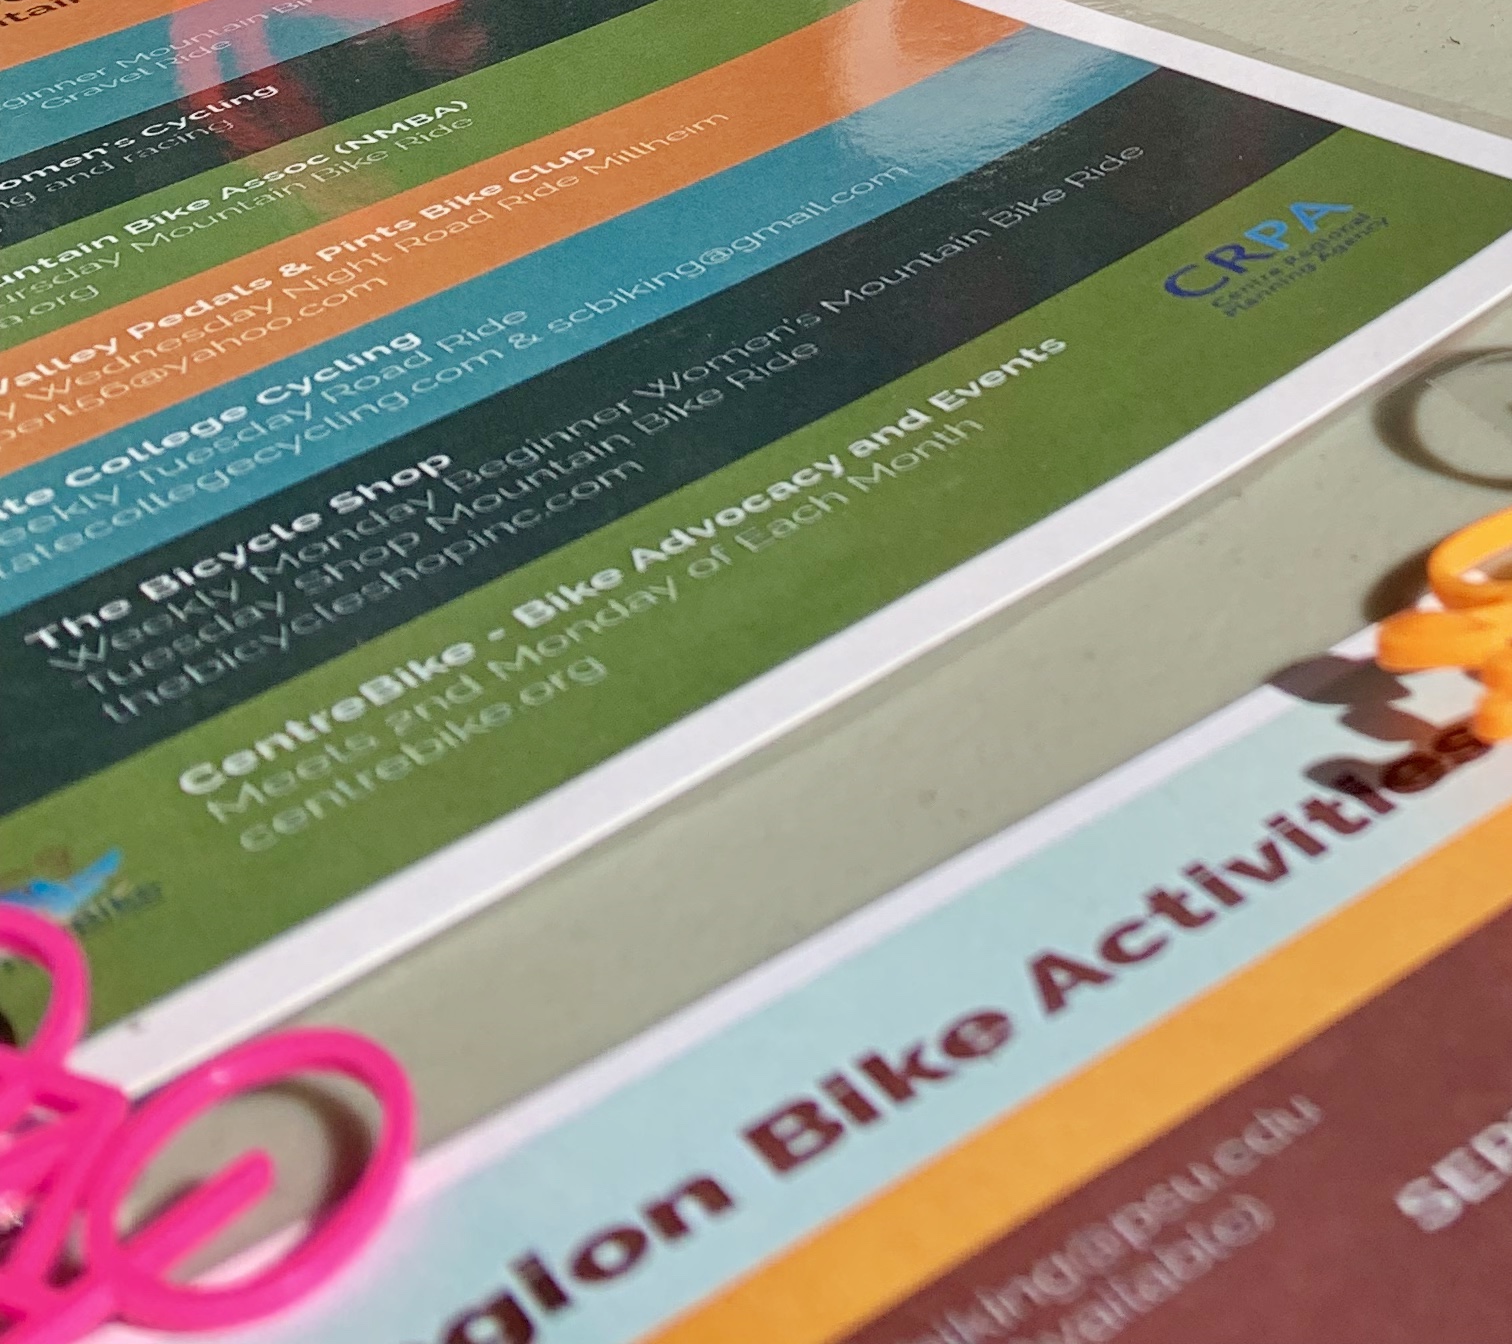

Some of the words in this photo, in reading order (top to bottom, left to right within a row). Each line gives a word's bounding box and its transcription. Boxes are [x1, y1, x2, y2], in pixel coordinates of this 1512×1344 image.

[23, 296, 273, 402] Wednesday
[280, 250, 393, 300] Night
[393, 207, 494, 254] Road
[495, 174, 580, 212] Ride
[581, 113, 729, 176] Millheim
[122, 198, 211, 236] Bike
[220, 153, 331, 201] Assoc
[333, 99, 468, 154] (NMBA)
[125, 276, 273, 340] Pedals
[277, 261, 313, 278] &
[314, 218, 417, 262] Pints
[417, 183, 504, 220] Bike
[507, 146, 596, 184] Club
[546, 159, 919, 334] scbiking@gmail.com
[1163, 201, 1354, 299] CRPA
[64, 405, 248, 487] College
[255, 331, 422, 405] Cycling
[23, 598, 131, 649] The
[138, 511, 322, 601] Bicycle
[328, 453, 451, 514] Shop
[178, 641, 476, 795] CentreBike
[511, 567, 624, 628] Bike
[630, 453, 845, 574] Advocacy
[846, 406, 933, 458] and
[926, 337, 1067, 412] Events
[741, 1007, 1018, 1176] Bike
[1027, 725, 1494, 1015] Activities
